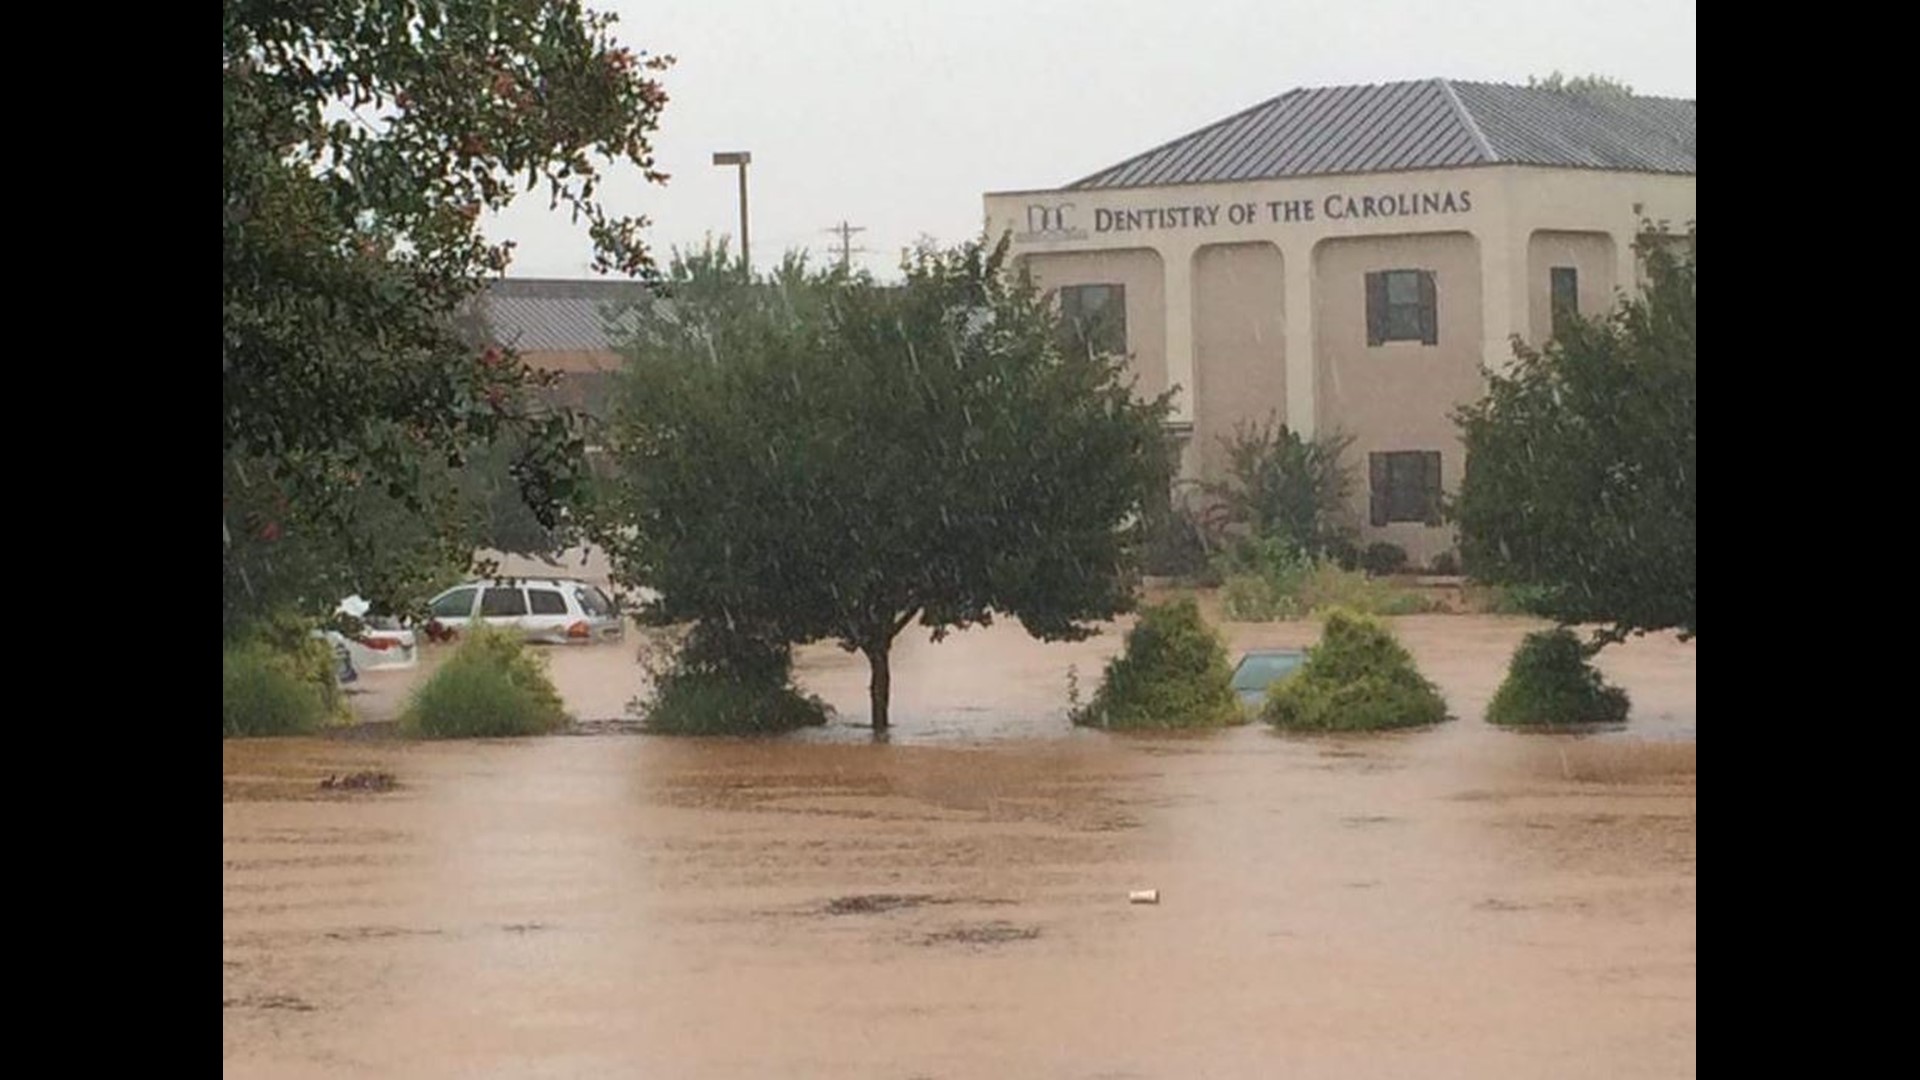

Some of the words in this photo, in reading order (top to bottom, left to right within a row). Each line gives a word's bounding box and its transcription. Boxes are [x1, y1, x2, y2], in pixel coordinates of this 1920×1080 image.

[1094, 203, 1219, 233] DENTISTRY
[1228, 203, 1258, 225] OF
[1272, 200, 1315, 223] THE
[1324, 190, 1472, 218] CAROLINAS
